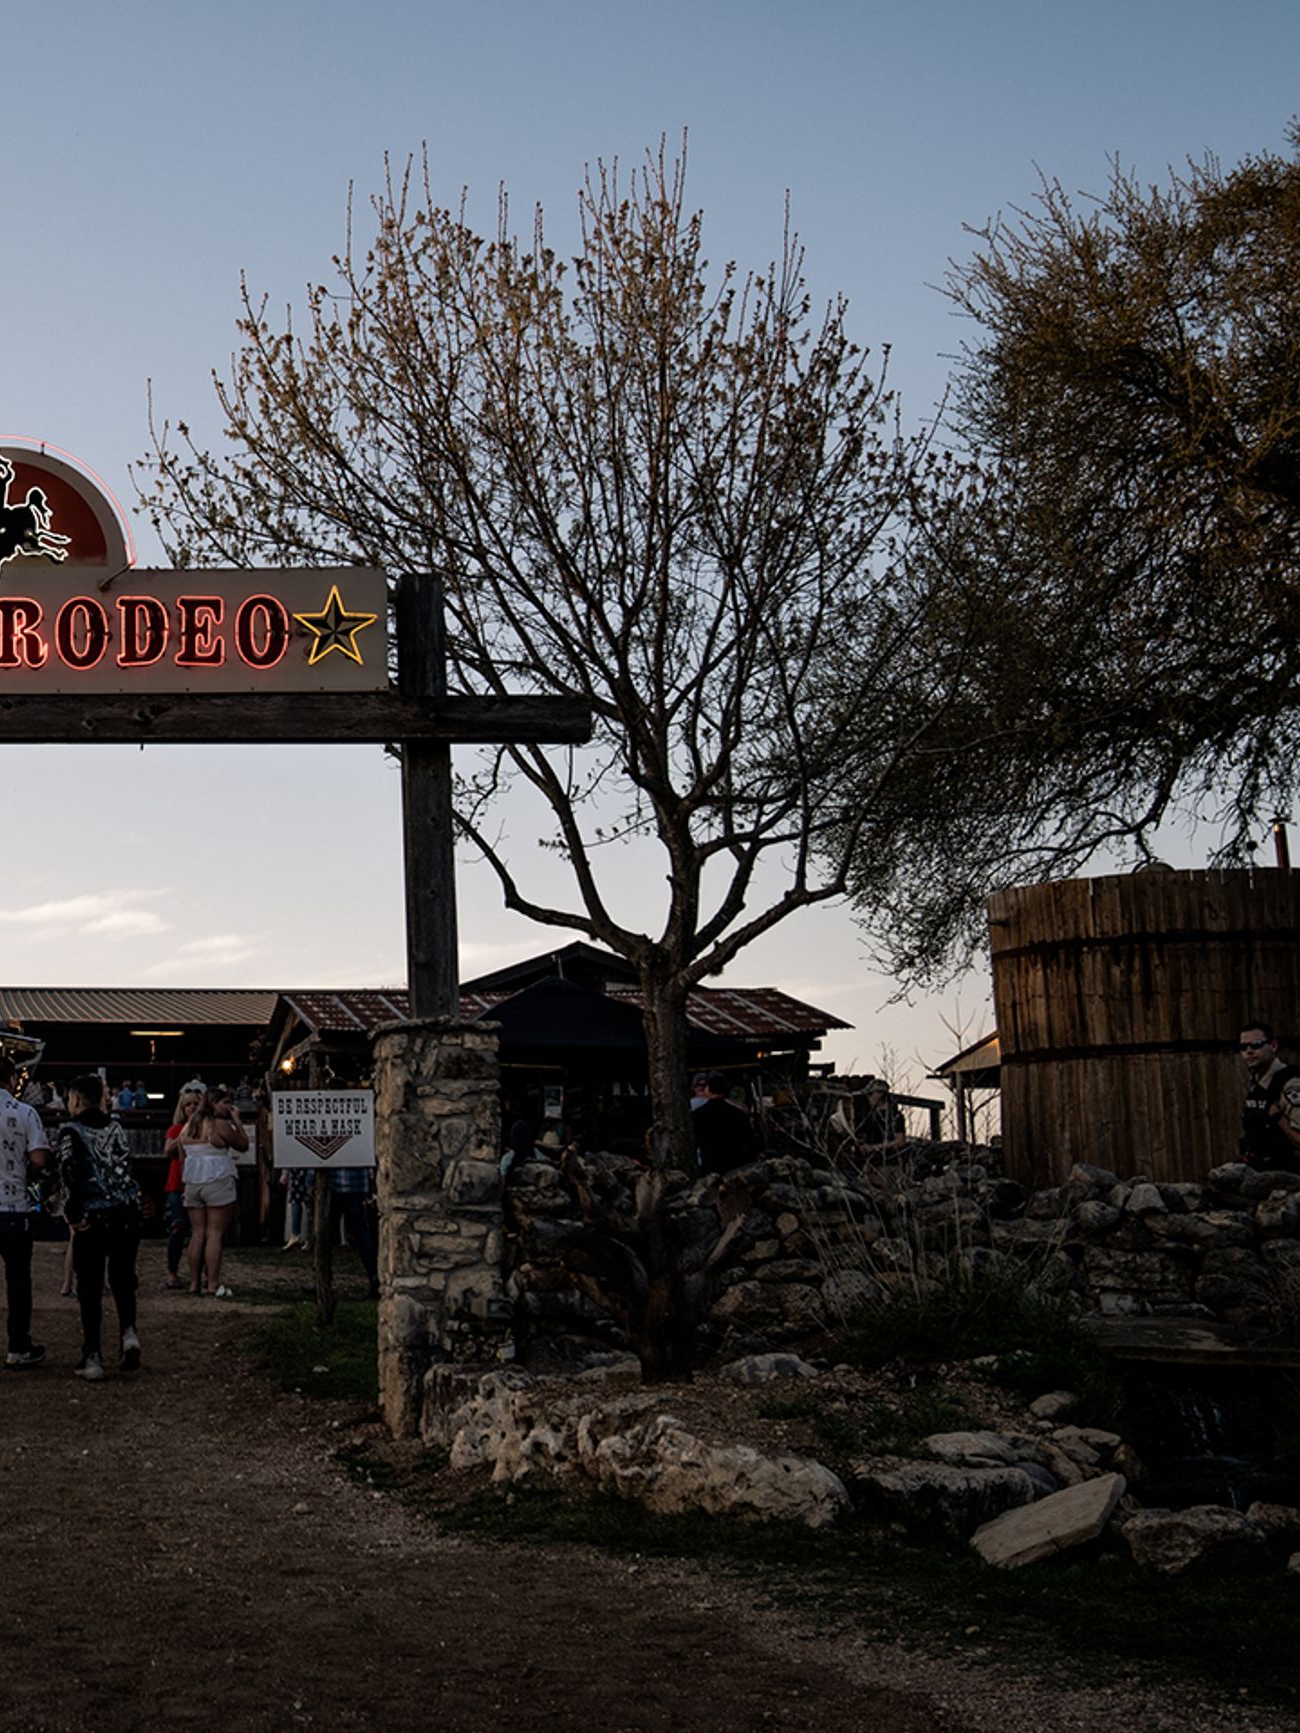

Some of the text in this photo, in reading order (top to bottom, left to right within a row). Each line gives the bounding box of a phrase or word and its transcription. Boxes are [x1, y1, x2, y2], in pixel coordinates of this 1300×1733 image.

[278, 1098, 367, 1115] BE RESPECTFUL
[285, 1119, 361, 1135] WEAR A MASK
